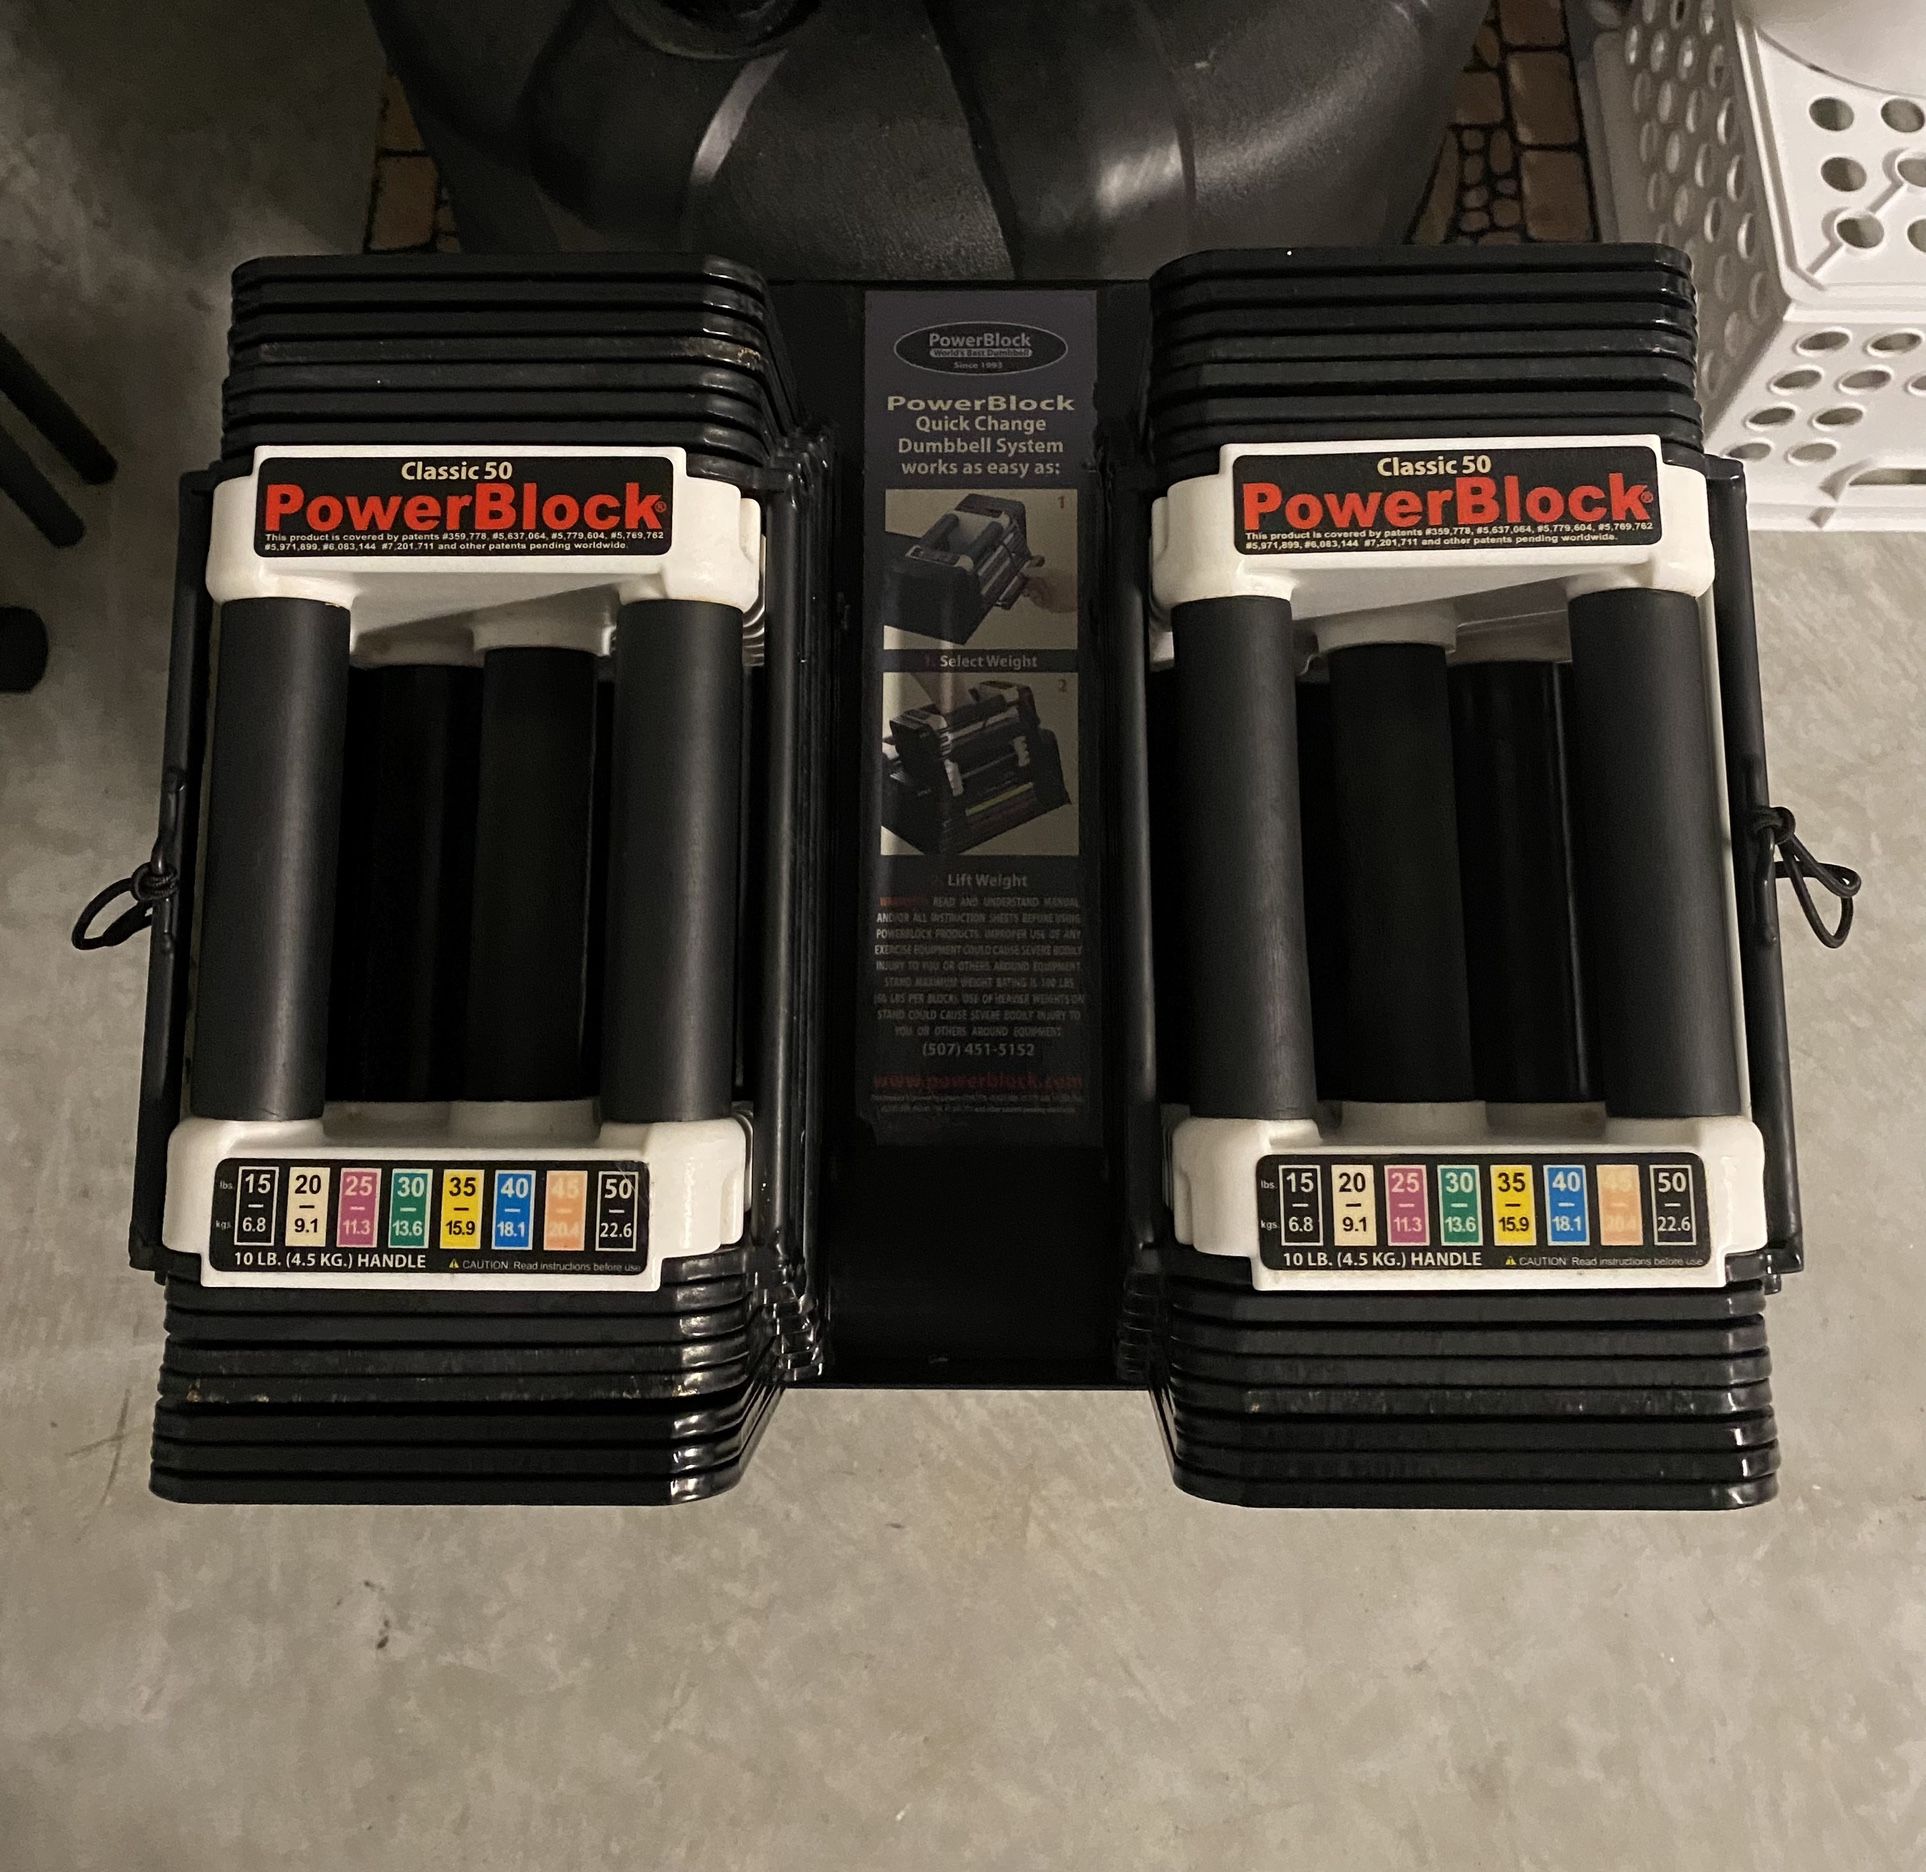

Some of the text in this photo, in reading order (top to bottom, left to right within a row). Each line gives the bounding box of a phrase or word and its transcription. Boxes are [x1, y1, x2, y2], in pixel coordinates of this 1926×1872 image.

[929, 332, 1032, 348] PowerBlock
[953, 360, 979, 370] Since
[887, 395, 1076, 411] PowerBlock
[916, 415, 1046, 434] Quick Change
[898, 437, 1064, 457] Dumbbell System
[401, 461, 513, 481] Classic 50
[901, 459, 1060, 479] works as easy as:
[1377, 454, 1492, 477] Classic 50
[1057, 495, 1066, 510] 1
[264, 533, 287, 543] This
[289, 533, 329, 545] product
[331, 533, 340, 543] is
[342, 533, 385, 543] covered
[387, 533, 400, 546] by
[401, 533, 440, 544] patents
[1245, 531, 1268, 545] This
[1270, 530, 1310, 546] product
[1313, 530, 1322, 542] is
[1324, 528, 1367, 543] covered
[1369, 527, 1383, 544] by
[1384, 527, 1423, 543] patents
[1421, 536, 1440, 548] and
[1443, 535, 1471, 547] other
[1473, 535, 1512, 549] patents
[1515, 533, 1559, 547] pending
[1560, 532, 1619, 545] worldwide.
[437, 542, 457, 551] and
[459, 541, 486, 551] other
[489, 541, 527, 553] patents
[529, 541, 572, 553] pending
[940, 655, 985, 668] Select
[986, 654, 1038, 671] Weight
[947, 873, 1029, 891] Lift Weight
[922, 1042, 1036, 1057] (507) 451-5152
[244, 1173, 272, 1194] 15
[294, 1174, 322, 1195] 20
[345, 1175, 373, 1197] 25
[397, 1176, 426, 1199] 30
[448, 1176, 477, 1198] 35
[500, 1177, 530, 1199] 40
[552, 1178, 580, 1200] 45
[604, 1178, 633, 1200] 50
[1286, 1172, 1315, 1193] 15
[1338, 1172, 1367, 1193] 20
[1391, 1172, 1420, 1194] 25
[1445, 1171, 1474, 1193] 30
[1497, 1172, 1526, 1193] 35
[1552, 1170, 1581, 1193] 40
[1657, 1172, 1687, 1193] 50
[242, 1217, 268, 1233] 6.8
[294, 1217, 319, 1234] 9.1
[342, 1219, 372, 1236] 11.3
[392, 1219, 425, 1237] 13.6
[445, 1220, 477, 1237] 15.9
[497, 1221, 526, 1238] 18.1
[599, 1221, 633, 1239] 22.6
[1288, 1216, 1314, 1233] 6.8
[1342, 1216, 1368, 1233] 9.1
[1393, 1216, 1423, 1233] 11.3
[1444, 1216, 1477, 1233] 13.6
[1498, 1216, 1530, 1233] 15.9
[1551, 1216, 1582, 1233] 18.1
[1656, 1216, 1692, 1233] 22.6
[234, 1252, 254, 1266] 10
[256, 1252, 282, 1267] LB.
[285, 1252, 316, 1270] (4.5
[319, 1253, 353, 1270] KG.)
[357, 1253, 427, 1269] HANDLE
[513, 1259, 539, 1271] Read
[540, 1260, 591, 1273] instructions
[593, 1262, 624, 1274] before
[1283, 1252, 1304, 1267] 10
[1306, 1252, 1333, 1267] LB.
[1337, 1252, 1368, 1269] (4.5
[1371, 1252, 1406, 1269] KG.)
[1410, 1251, 1483, 1267] HANDLE
[1571, 1256, 1598, 1267] Read
[1599, 1256, 1652, 1267] instructions
[1653, 1256, 1684, 1267] before
